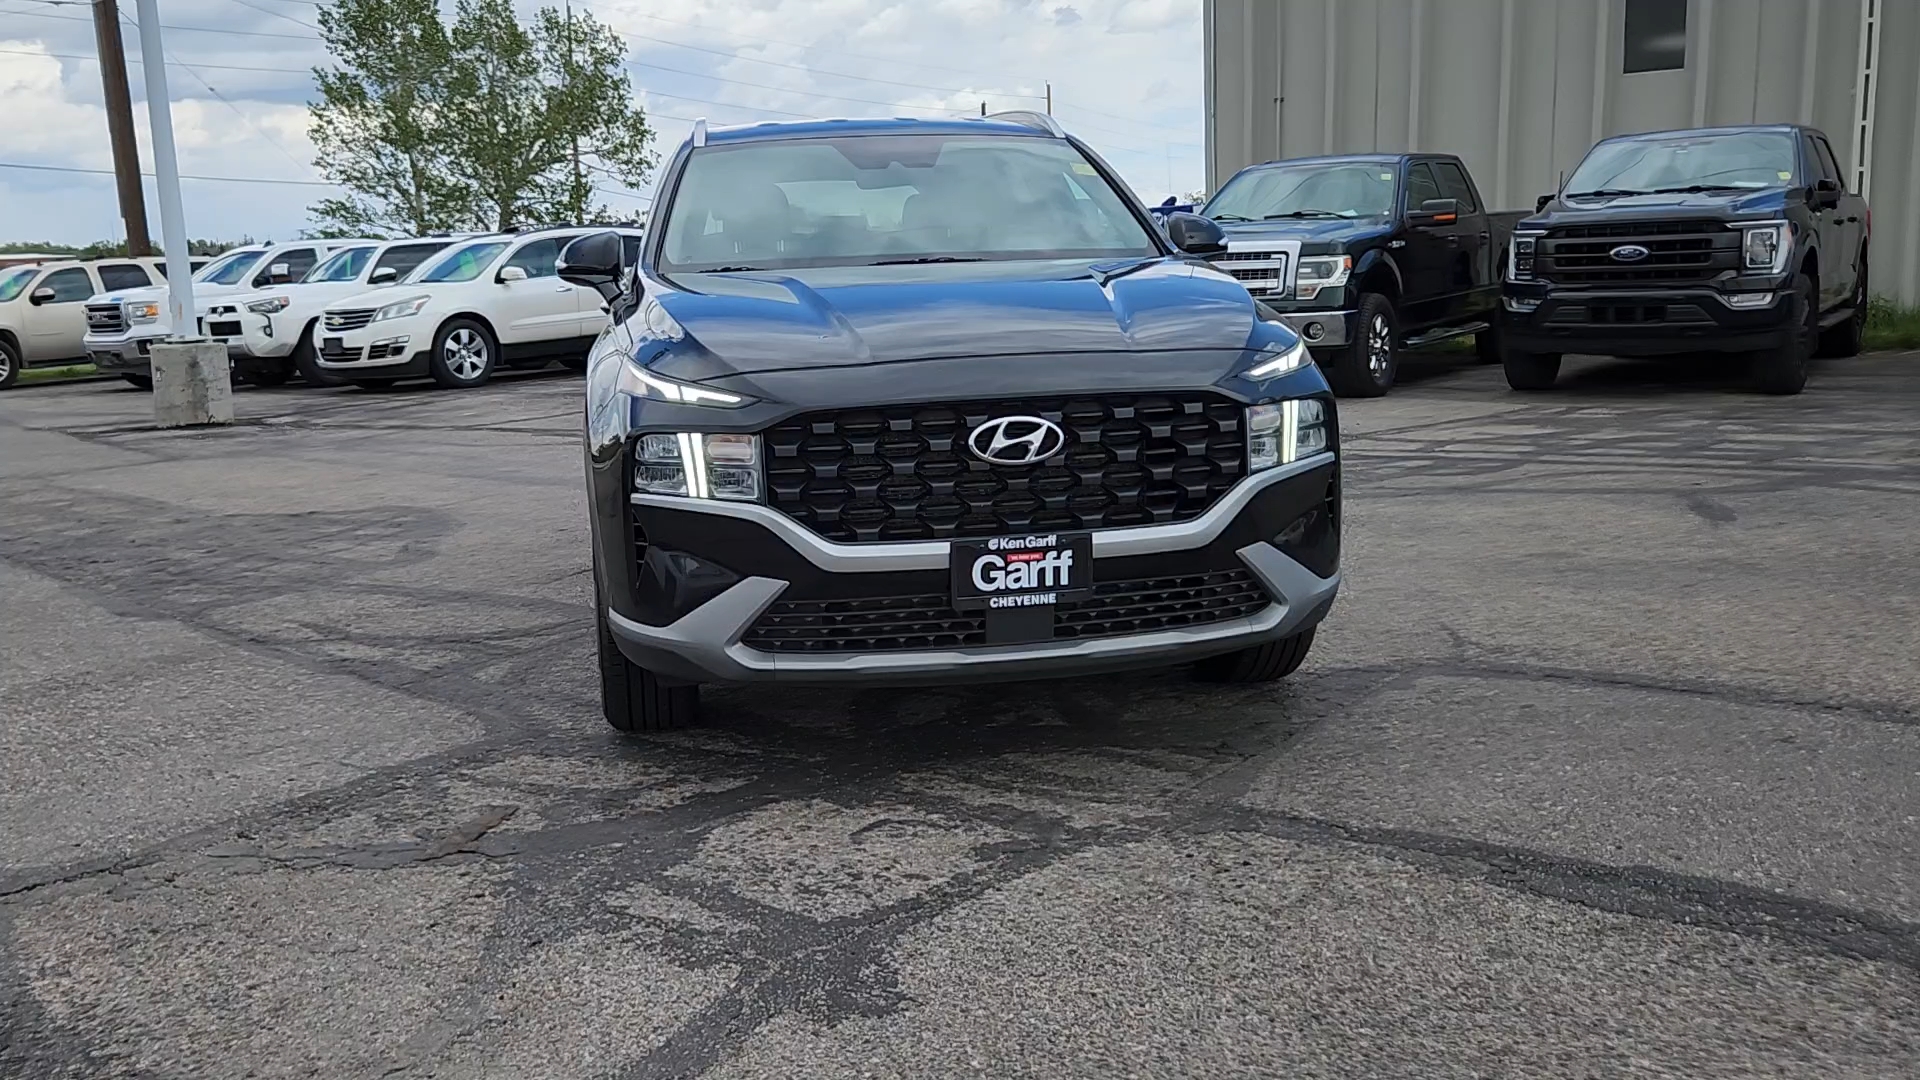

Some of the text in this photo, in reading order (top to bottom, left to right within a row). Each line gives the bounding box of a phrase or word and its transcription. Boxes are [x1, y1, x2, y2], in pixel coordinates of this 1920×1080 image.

[1000, 534, 1057, 550] Ken Garff
[972, 549, 1073, 592] Garff
[990, 593, 1057, 608] CHEYENNE
